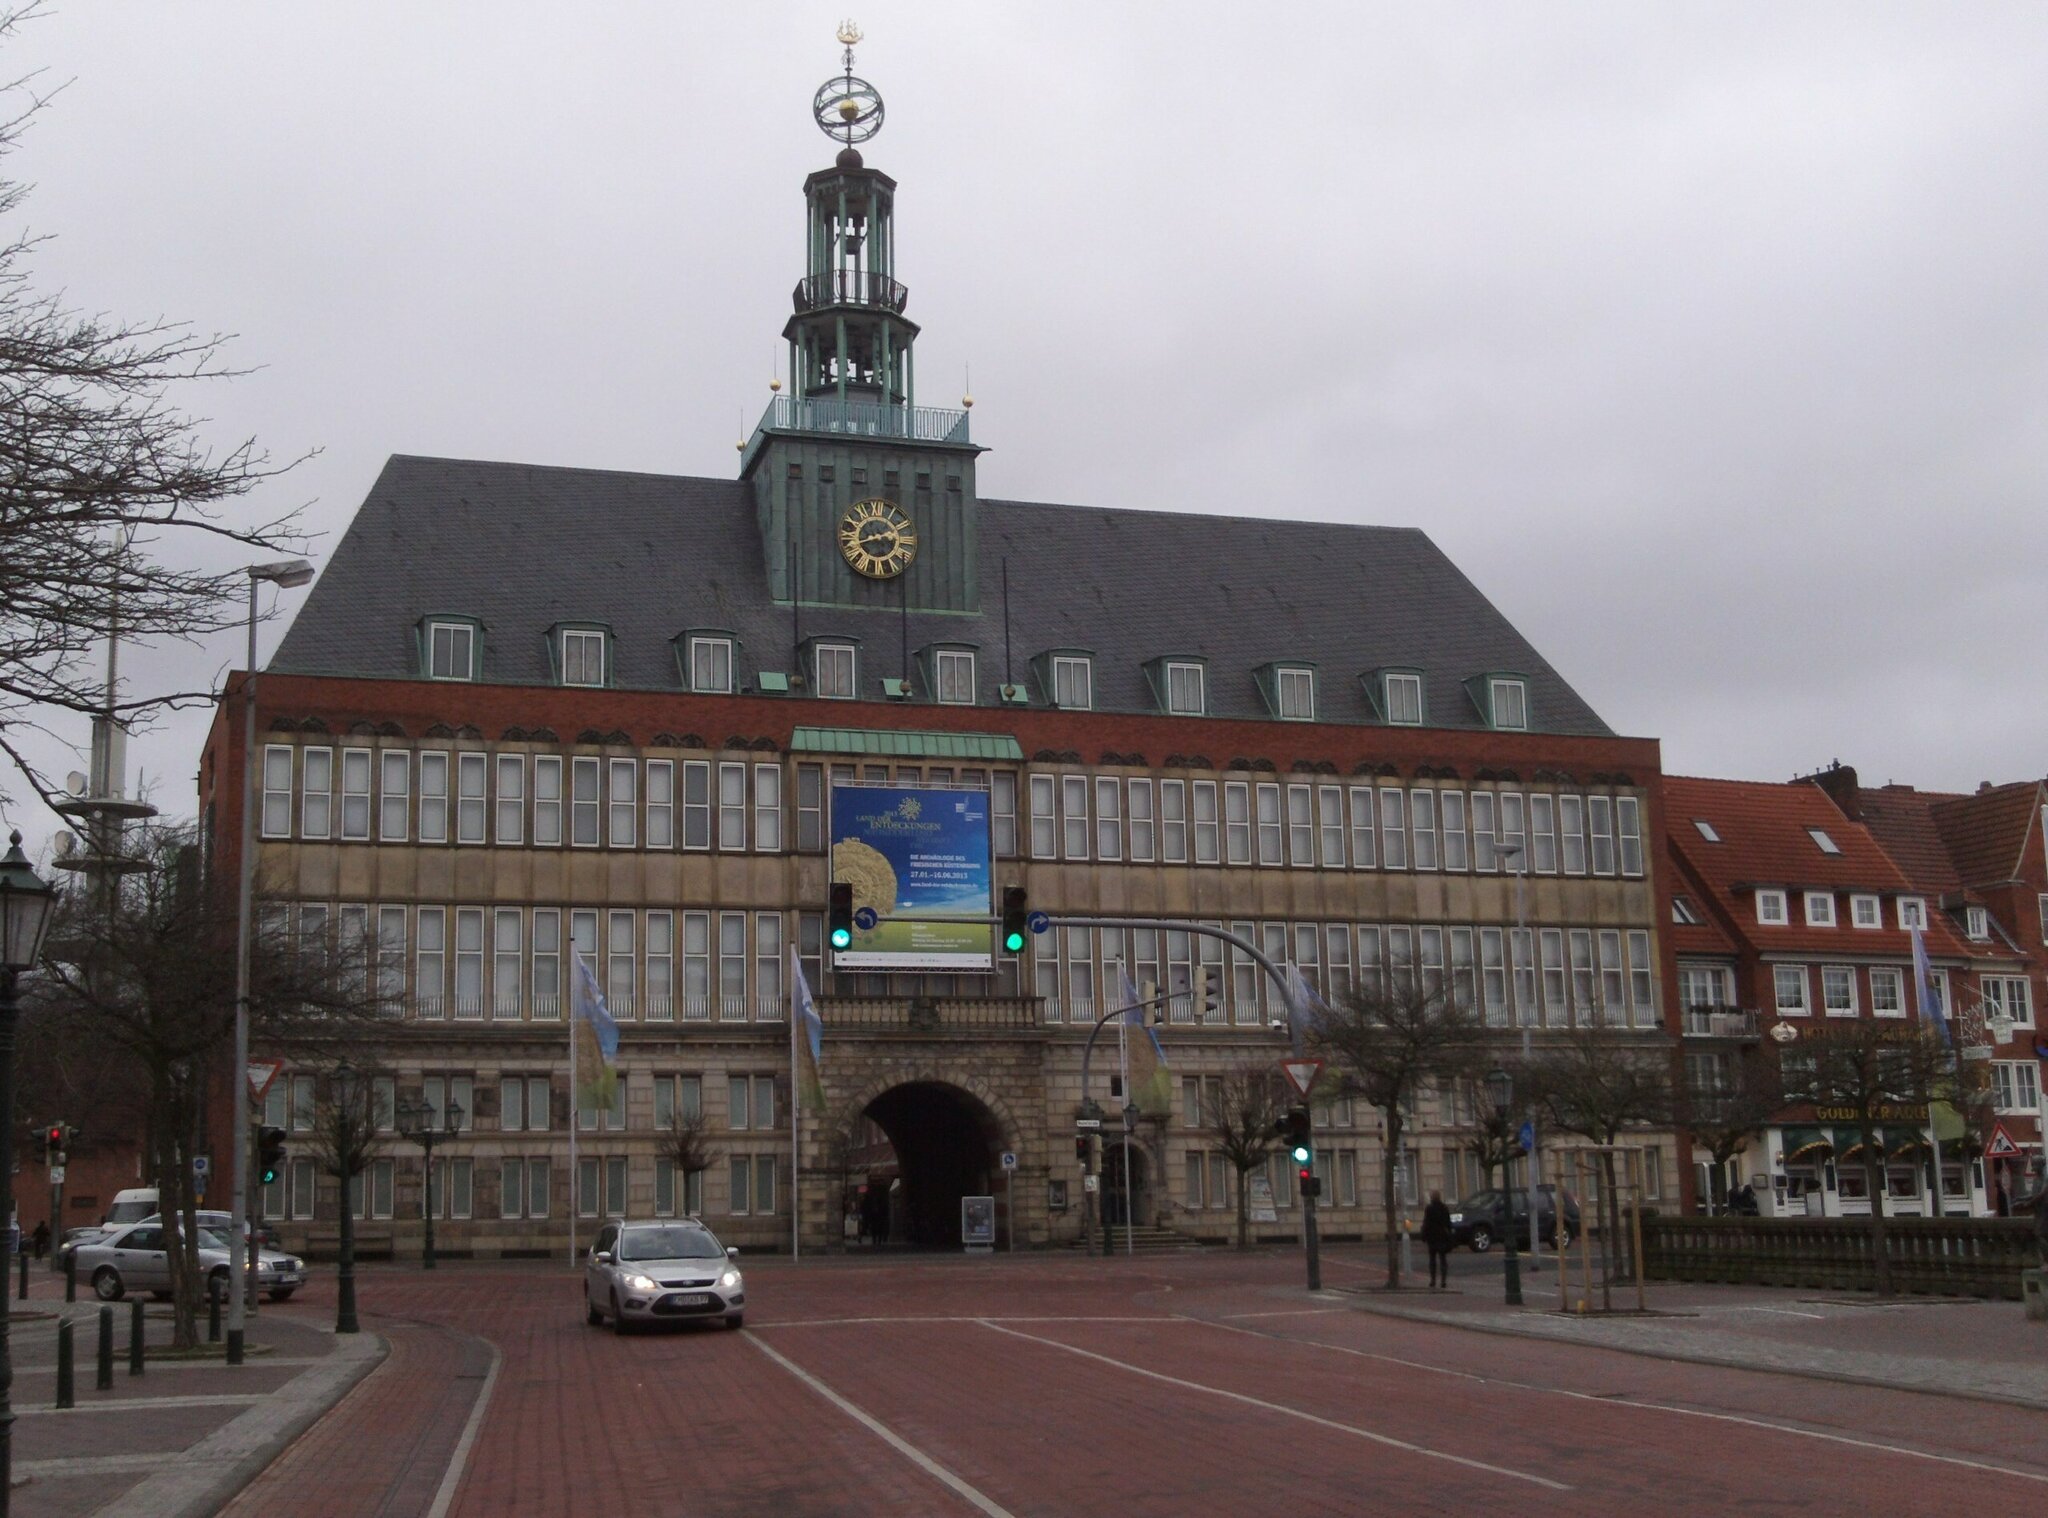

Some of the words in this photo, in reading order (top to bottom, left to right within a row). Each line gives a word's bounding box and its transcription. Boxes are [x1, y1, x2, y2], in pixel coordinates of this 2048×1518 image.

[855, 503, 869, 519] XI
[870, 501, 884, 517] XII
[845, 514, 859, 527] X
[870, 820, 941, 831] ENTDECKUNGEN
[1894, 1105, 1929, 1119] ADLE
